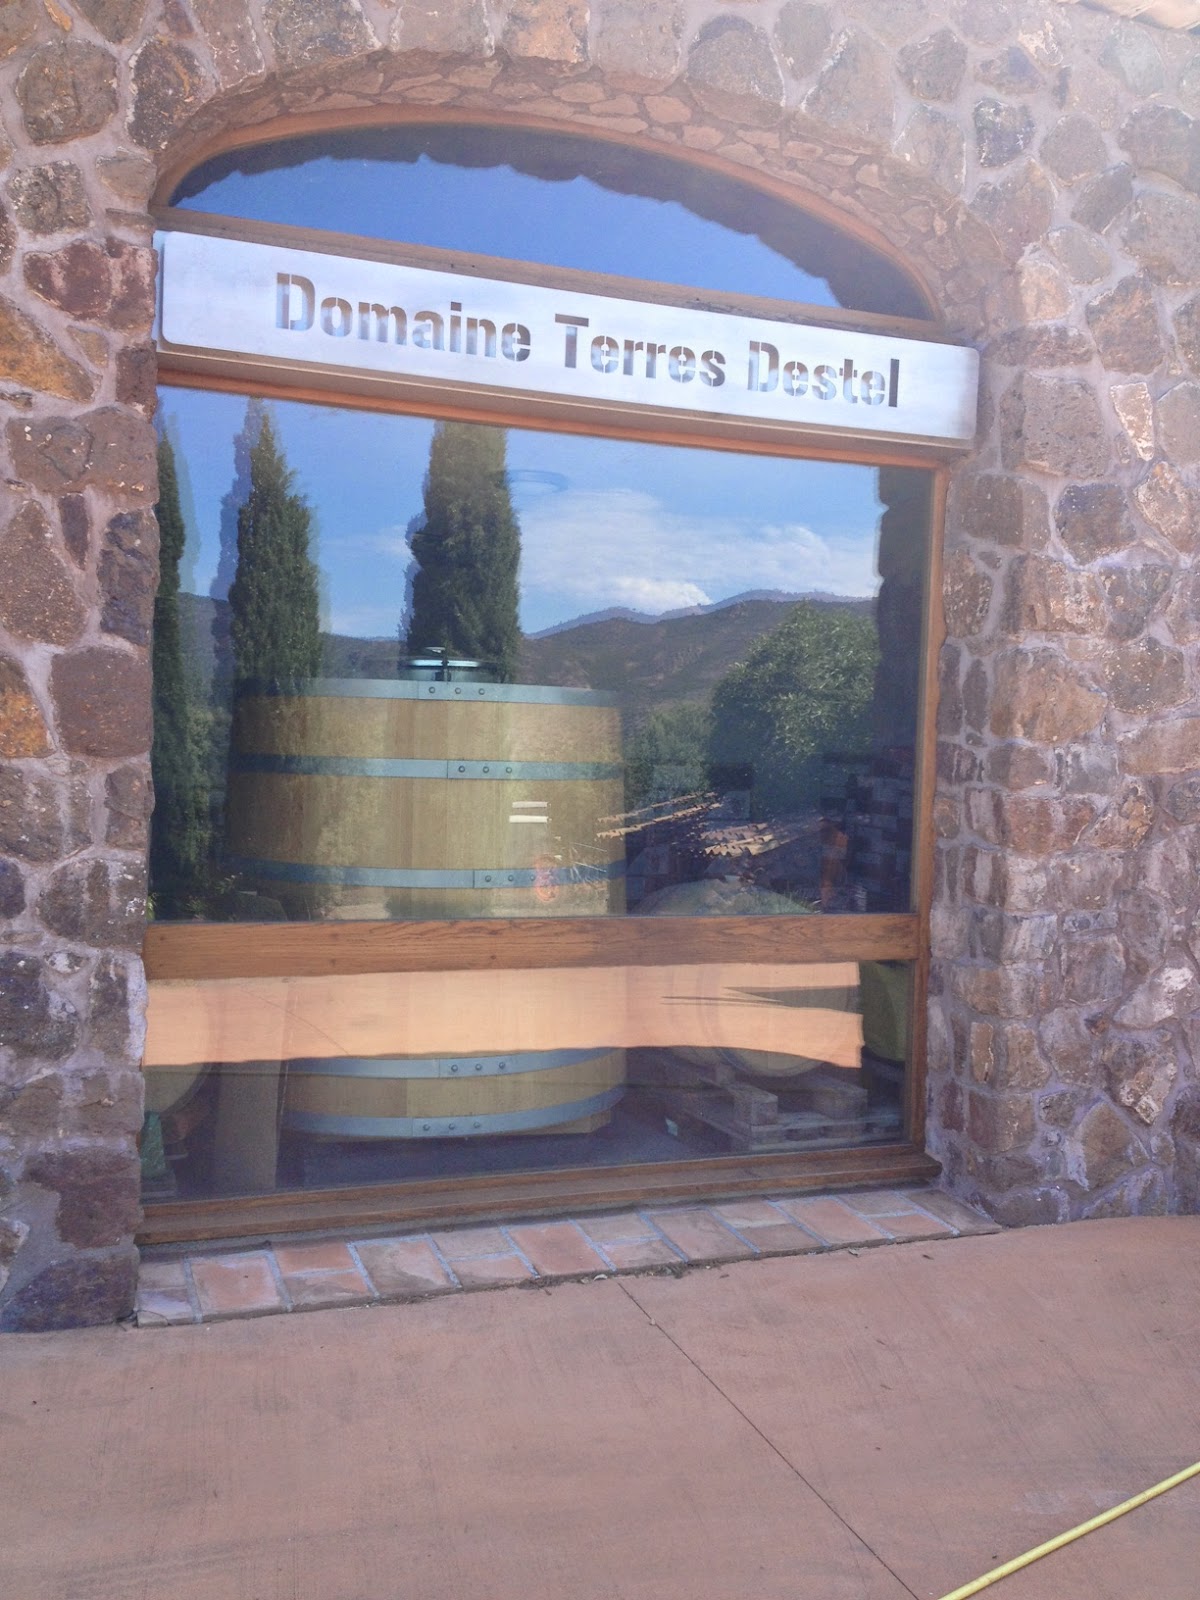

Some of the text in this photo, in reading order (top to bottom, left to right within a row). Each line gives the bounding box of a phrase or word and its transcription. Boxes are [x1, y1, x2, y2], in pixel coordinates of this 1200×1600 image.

[275, 272, 900, 408] Domaine Terres Destel
